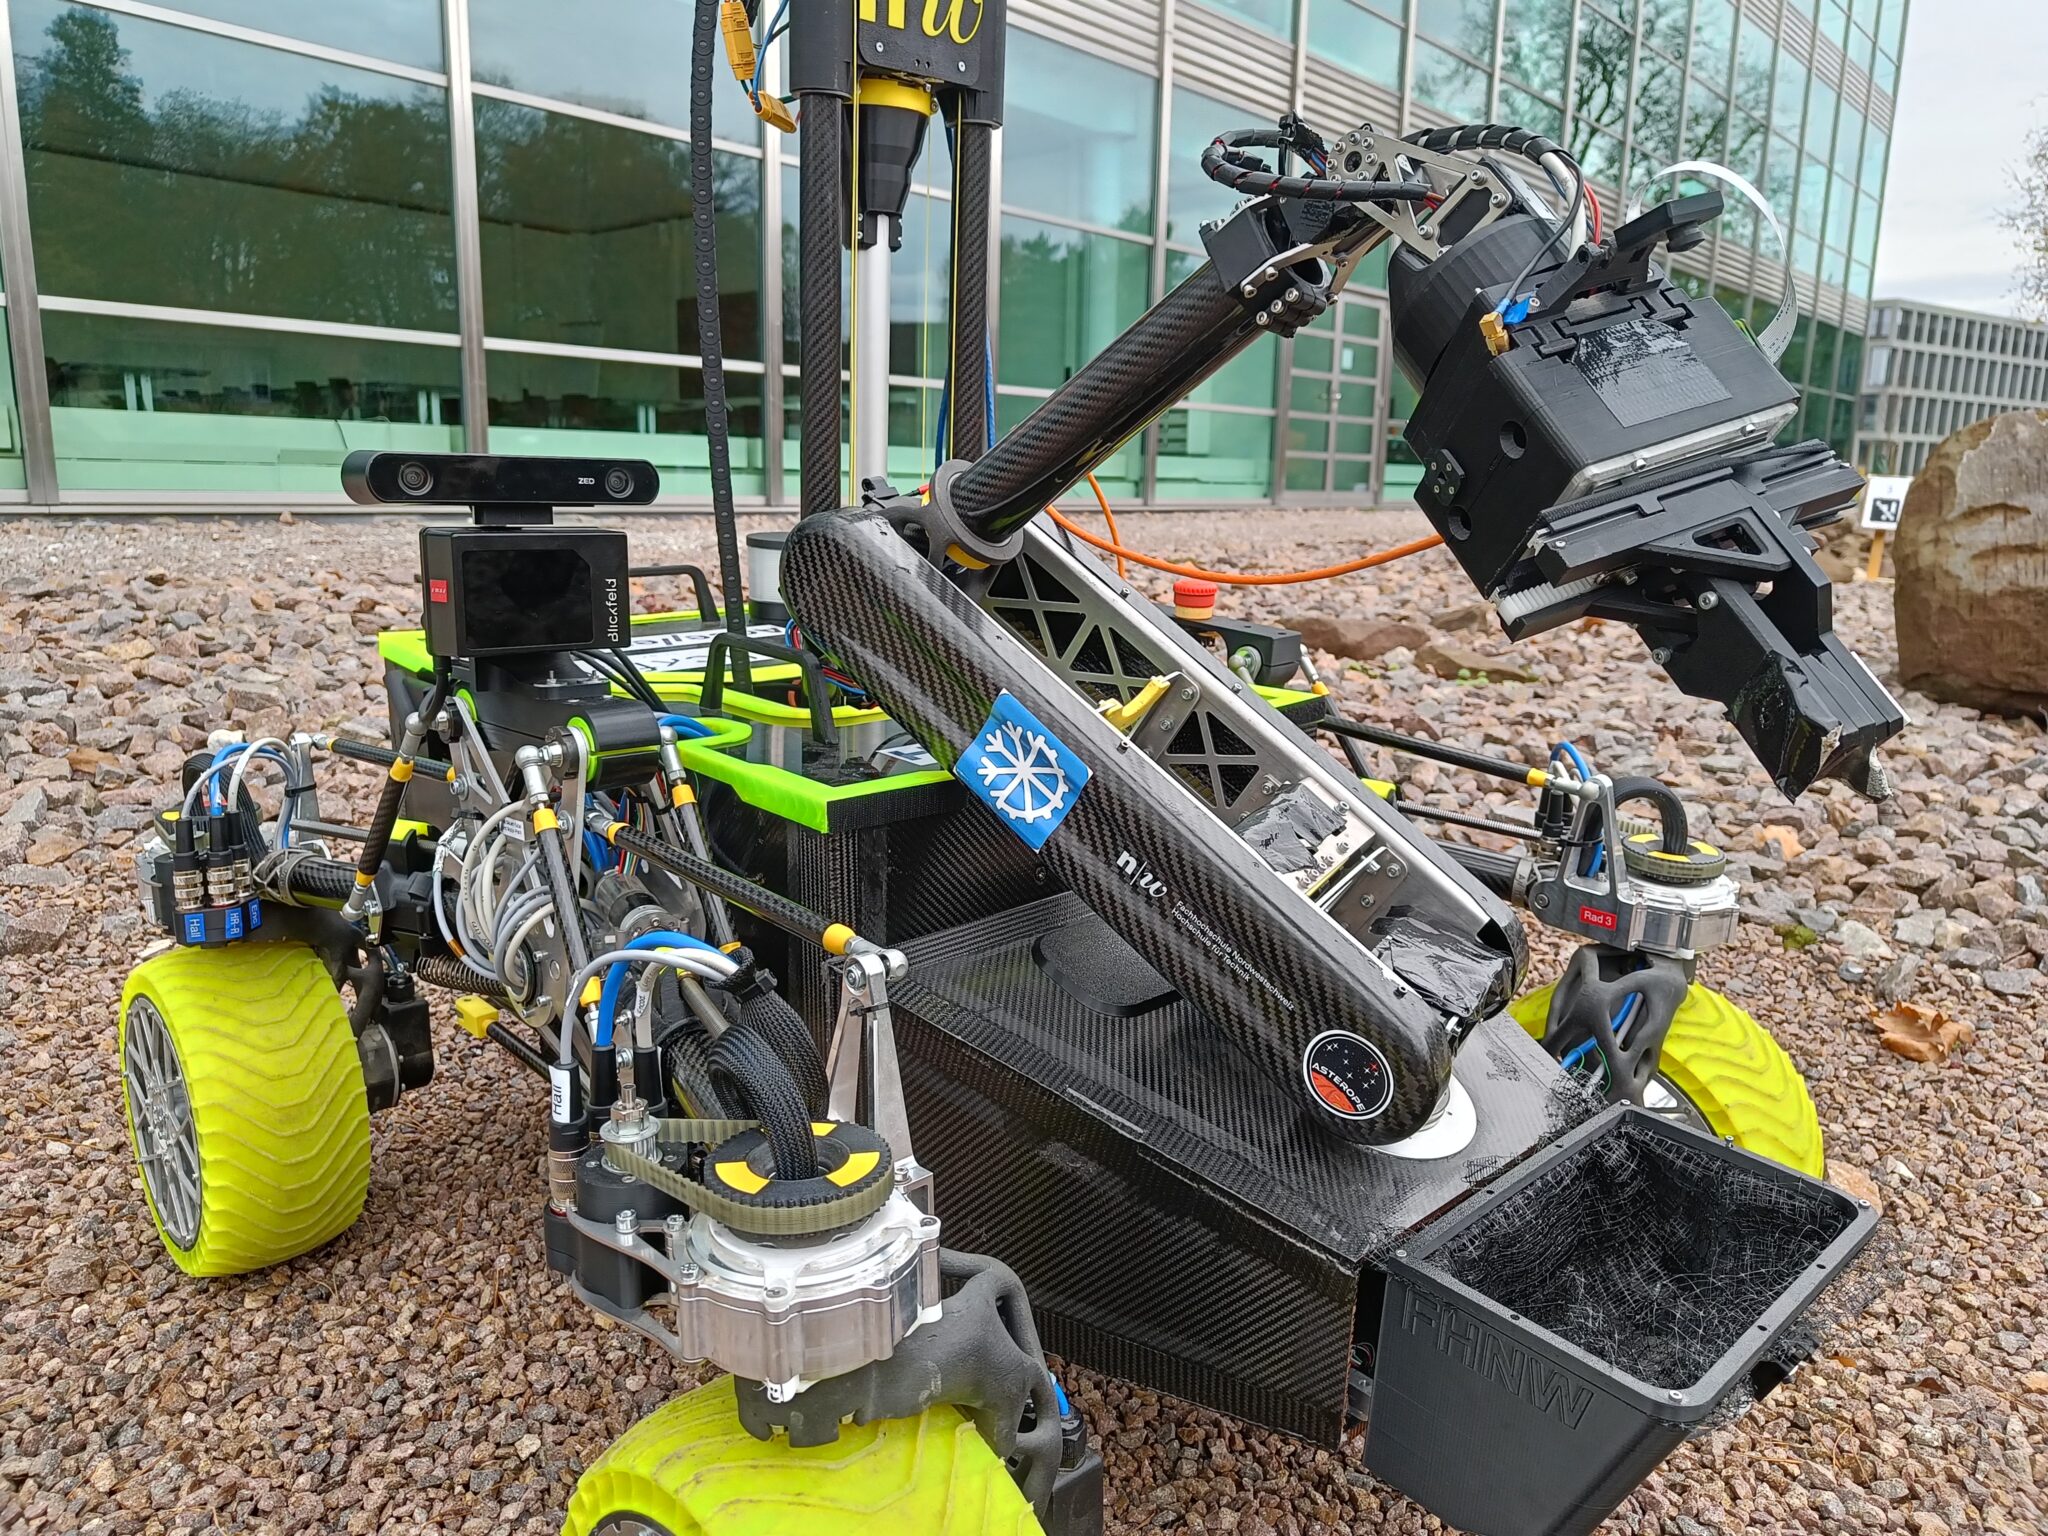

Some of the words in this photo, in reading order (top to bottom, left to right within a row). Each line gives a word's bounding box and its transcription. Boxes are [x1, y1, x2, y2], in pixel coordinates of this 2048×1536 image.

[577, 477, 595, 485] ZED
[189, 918, 201, 938] Hall
[1583, 910, 1604, 924] Rad
[1605, 915, 1612, 925] 3
[1171, 907, 1212, 947] Hochschule
[1211, 944, 1223, 957] für
[1223, 953, 1252, 982] Technik
[1177, 900, 1232, 953] Fachhochschule
[1231, 950, 1295, 1011] Nordwestschweiz
[552, 1084, 562, 1116] Hall
[1312, 1062, 1366, 1112] ASTEROPE
[1402, 1283, 1595, 1431] FHNW
